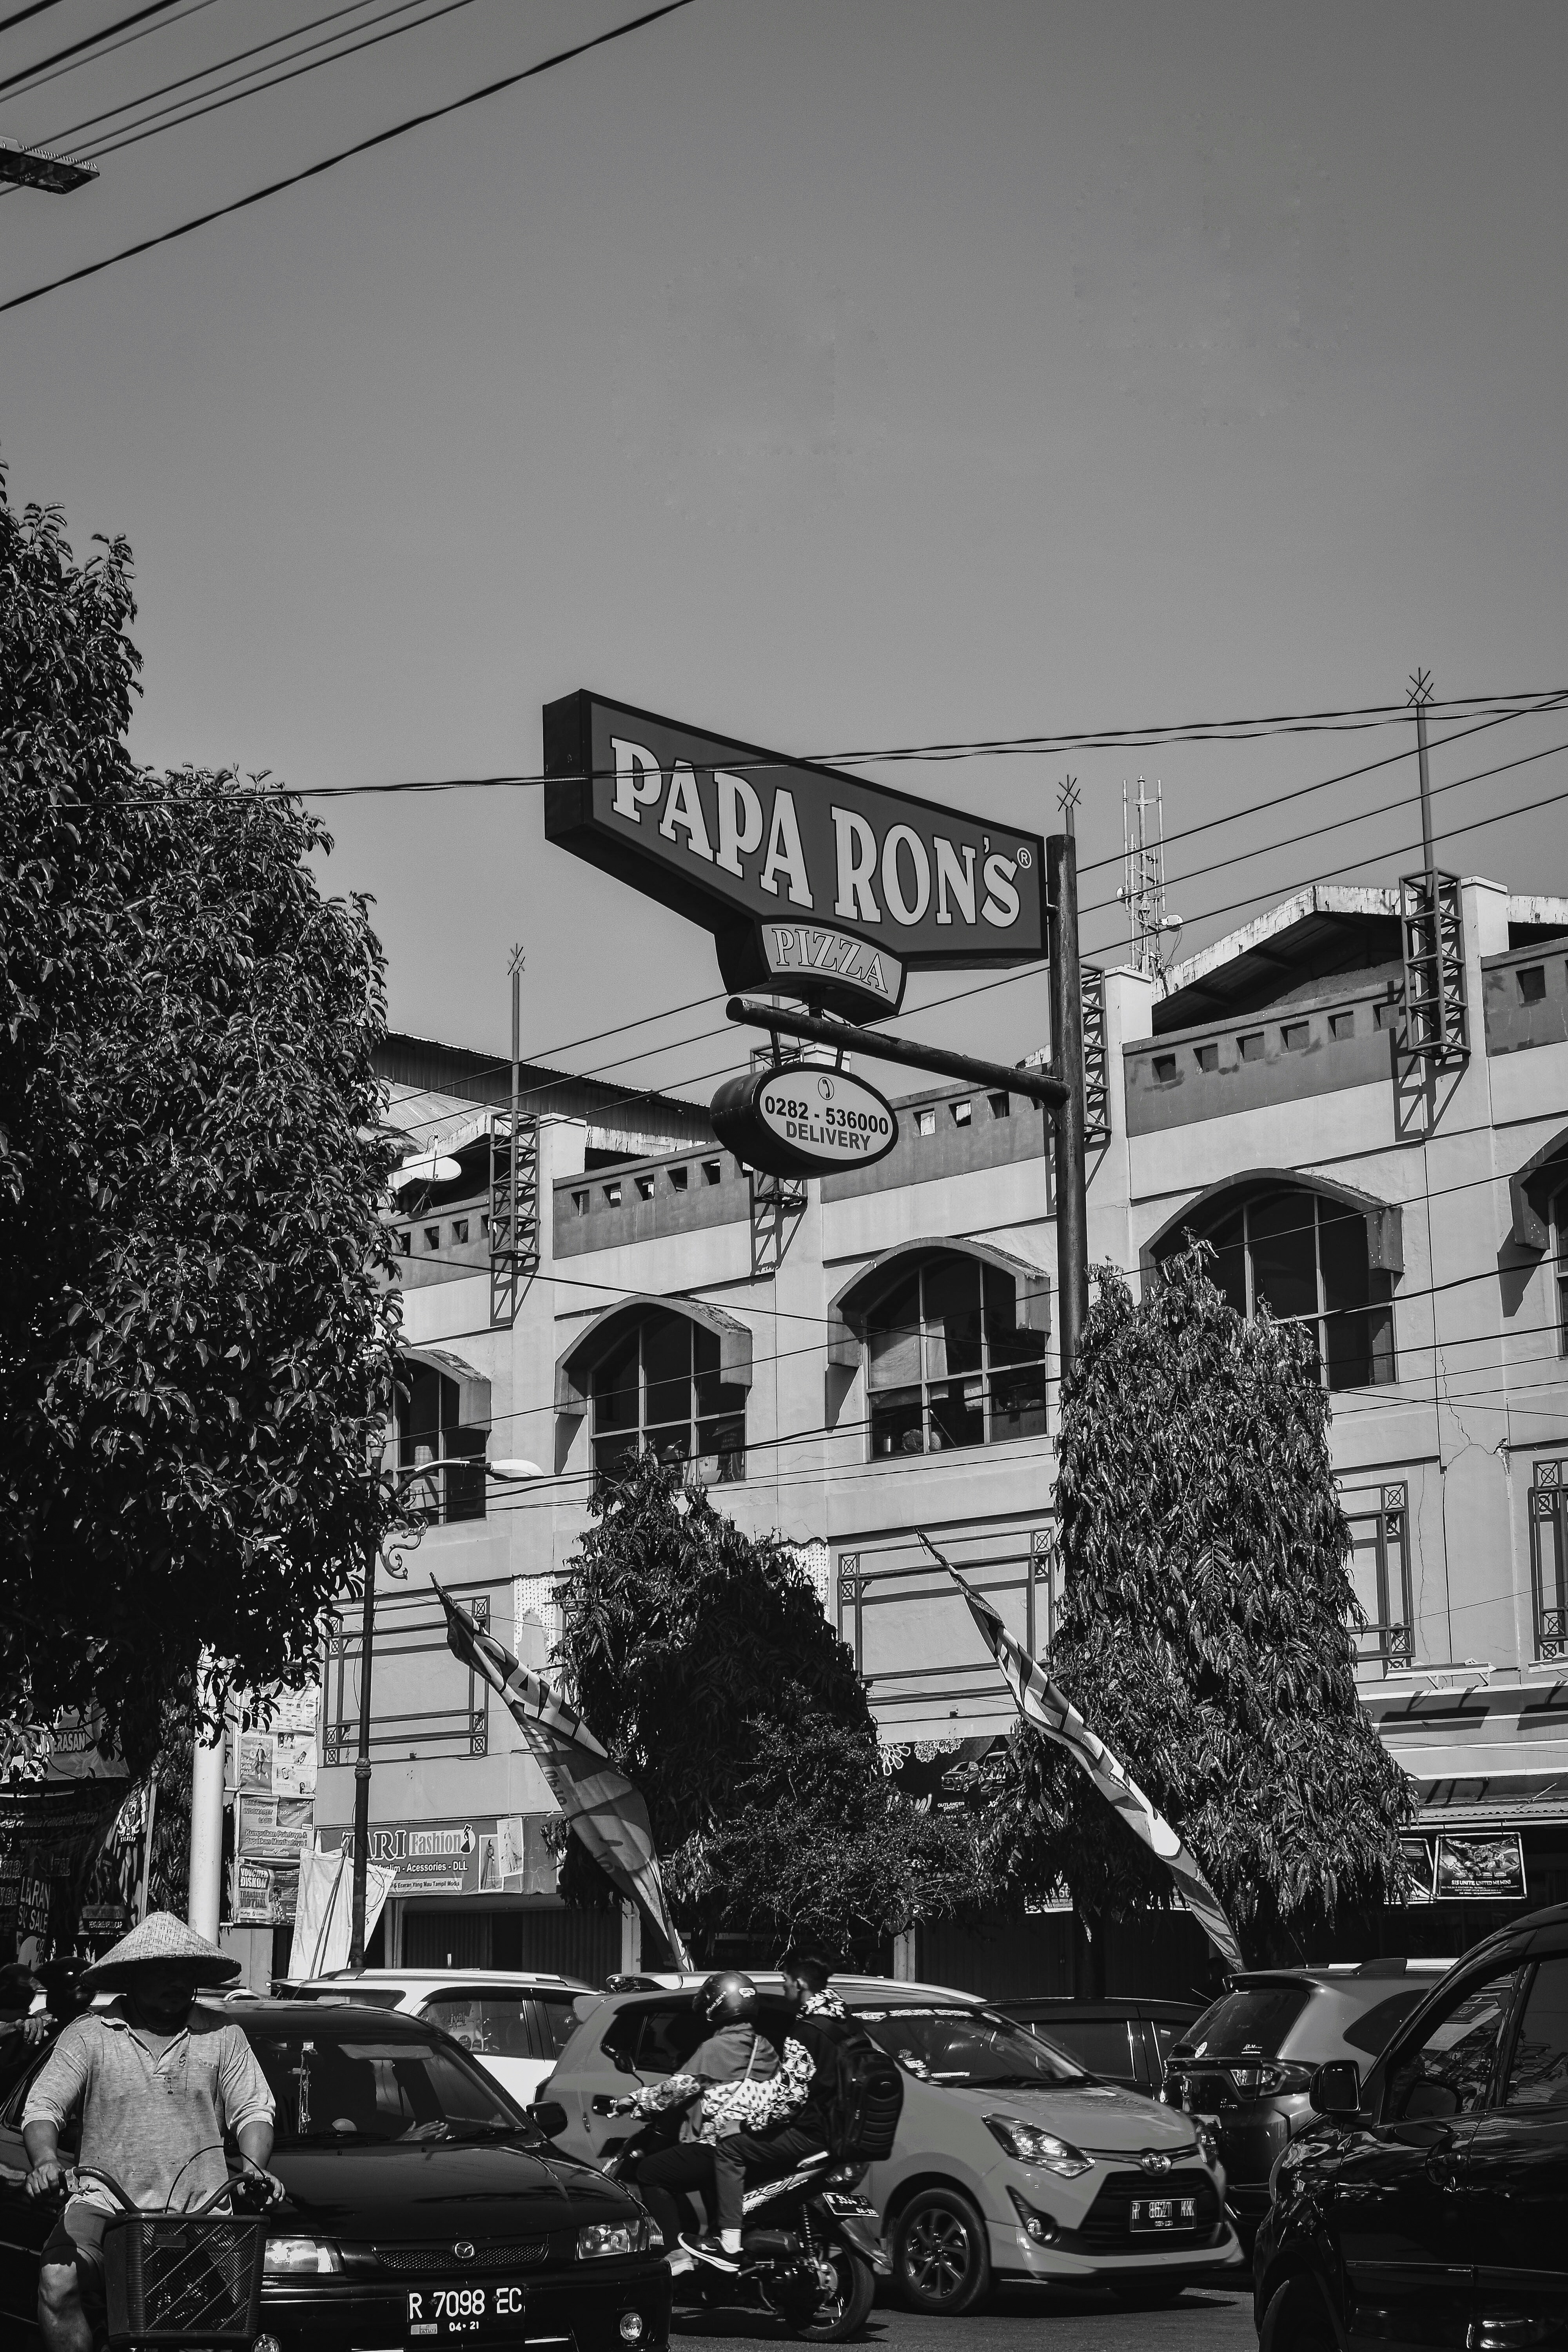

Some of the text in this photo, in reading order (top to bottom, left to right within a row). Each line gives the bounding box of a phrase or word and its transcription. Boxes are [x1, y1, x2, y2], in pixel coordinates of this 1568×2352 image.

[610, 736, 1020, 928] PAPA RON'S
[771, 927, 889, 995] PIZZA
[764, 1096, 809, 1121] 0282
[825, 1107, 889, 1135] 536000
[786, 1120, 871, 1151] DELIVERY
[245, 1829, 276, 1837] Kumpulkan
[412, 1831, 461, 1855] Fashion
[240, 1868, 269, 1878] VOUCHER
[406, 1861, 446, 1873] Acessories
[453, 1860, 468, 1871] DLL
[240, 1876, 268, 1888] DISKON
[29, 1909, 49, 1934] SALE
[1132, 2202, 1140, 2219] R
[409, 2287, 522, 2319] R 7098 EC
